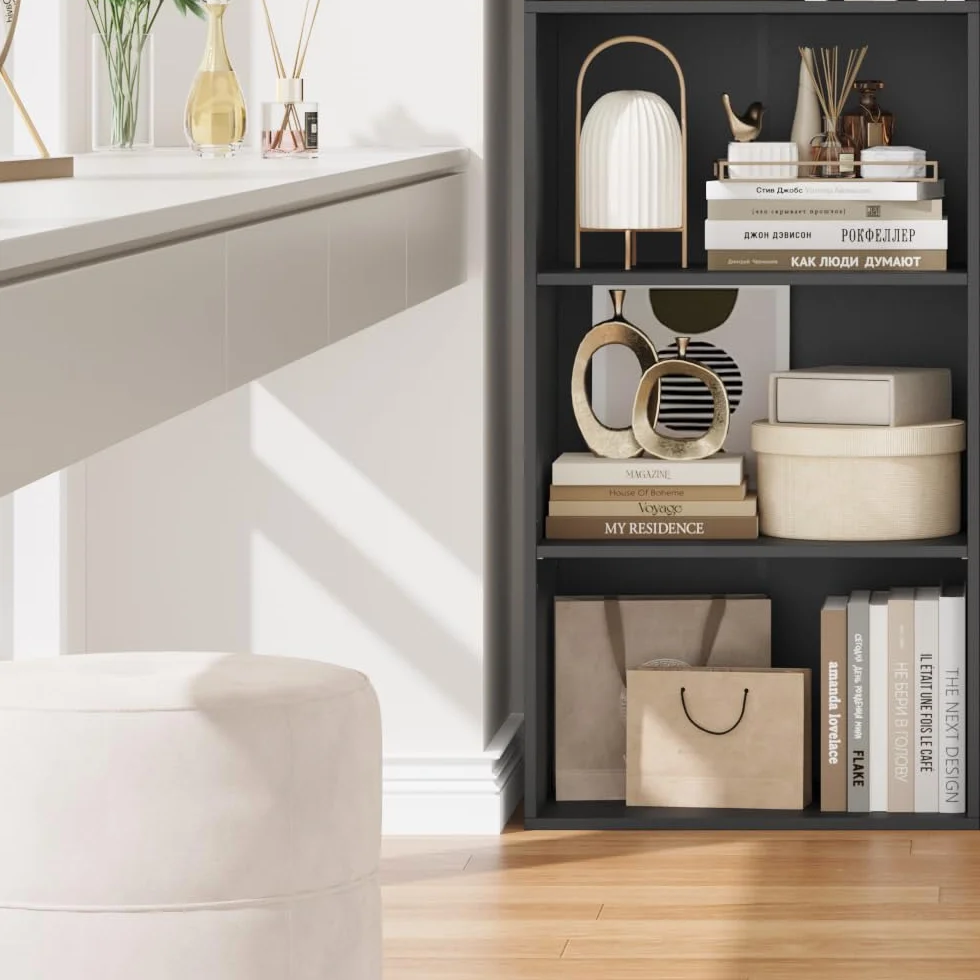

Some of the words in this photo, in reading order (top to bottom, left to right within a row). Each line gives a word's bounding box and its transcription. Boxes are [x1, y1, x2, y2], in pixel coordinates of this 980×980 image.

[777, 186, 803, 195] Джобс
[744, 231, 769, 240] ДЖОН
[772, 231, 812, 240] ДЭВИСОН
[841, 228, 916, 243] РОКФЕЛЛЕР
[791, 256, 816, 268] КАК
[819, 256, 859, 269] ЛЮДИ
[864, 256, 922, 269] ДУМАЮТ
[625, 469, 672, 480] MAGAZINE
[608, 488, 635, 498] House
[638, 502, 683, 517] Voyage
[605, 522, 626, 536] MY
[629, 522, 705, 536] RESIDENCE
[920, 653, 932, 662] IL
[895, 662, 909, 680] НЕ
[920, 664, 935, 690] ÉTAIT
[828, 661, 840, 711] amanda
[945, 667, 960, 697] THE
[895, 682, 909, 716] БЕРИ
[920, 692, 932, 712] UNE
[895, 718, 909, 728] В
[920, 713, 932, 733] FOIS
[945, 702, 960, 741] NEXT
[828, 713, 840, 765] lovelace
[920, 735, 932, 747] LE
[894, 731, 909, 783] ГОЛОВУ
[920, 748, 935, 773] CAFÉ
[852, 750, 865, 787] FLAKE
[945, 746, 960, 804] DESIGN
